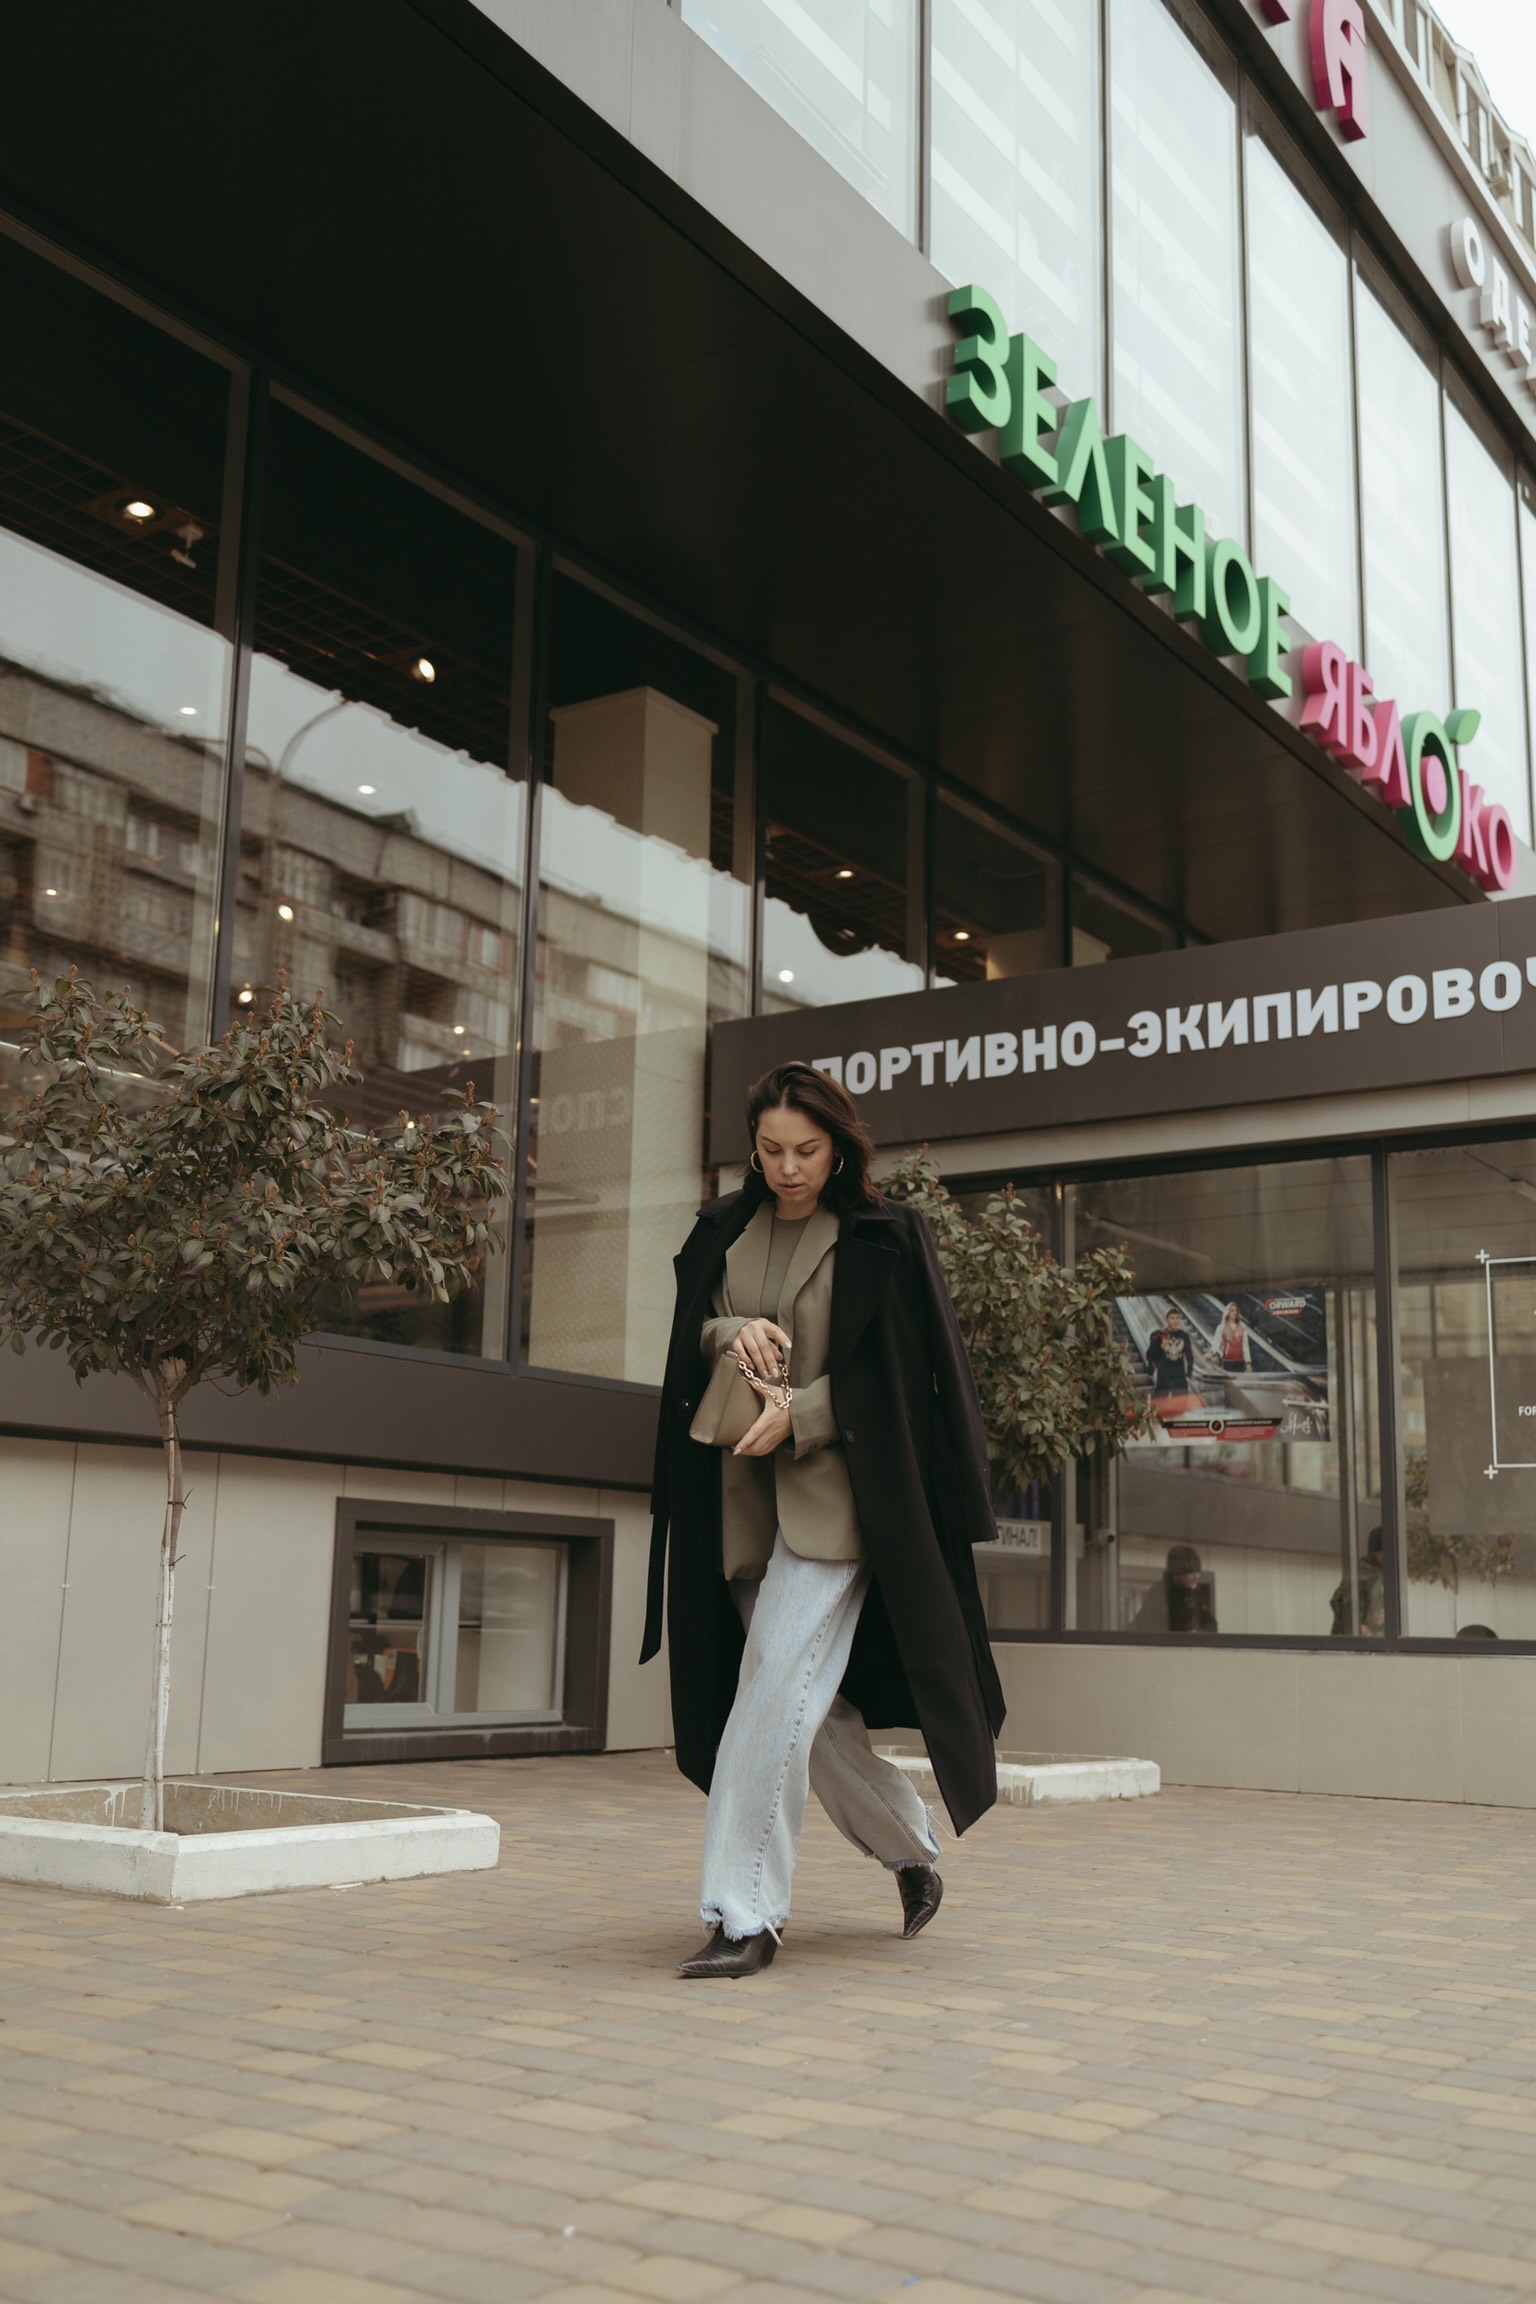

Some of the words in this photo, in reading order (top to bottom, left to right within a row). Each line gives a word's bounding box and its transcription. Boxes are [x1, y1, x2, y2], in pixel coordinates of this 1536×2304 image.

[1450, 217, 1536, 395] ОДЕ
[946, 284, 1292, 700] ЗЕЛЕНОЕ
[1299, 640, 1517, 893] ЯБЛОКО
[787, 956, 1536, 1095] ПОРТИВНО-ЭКИПИРОВО
